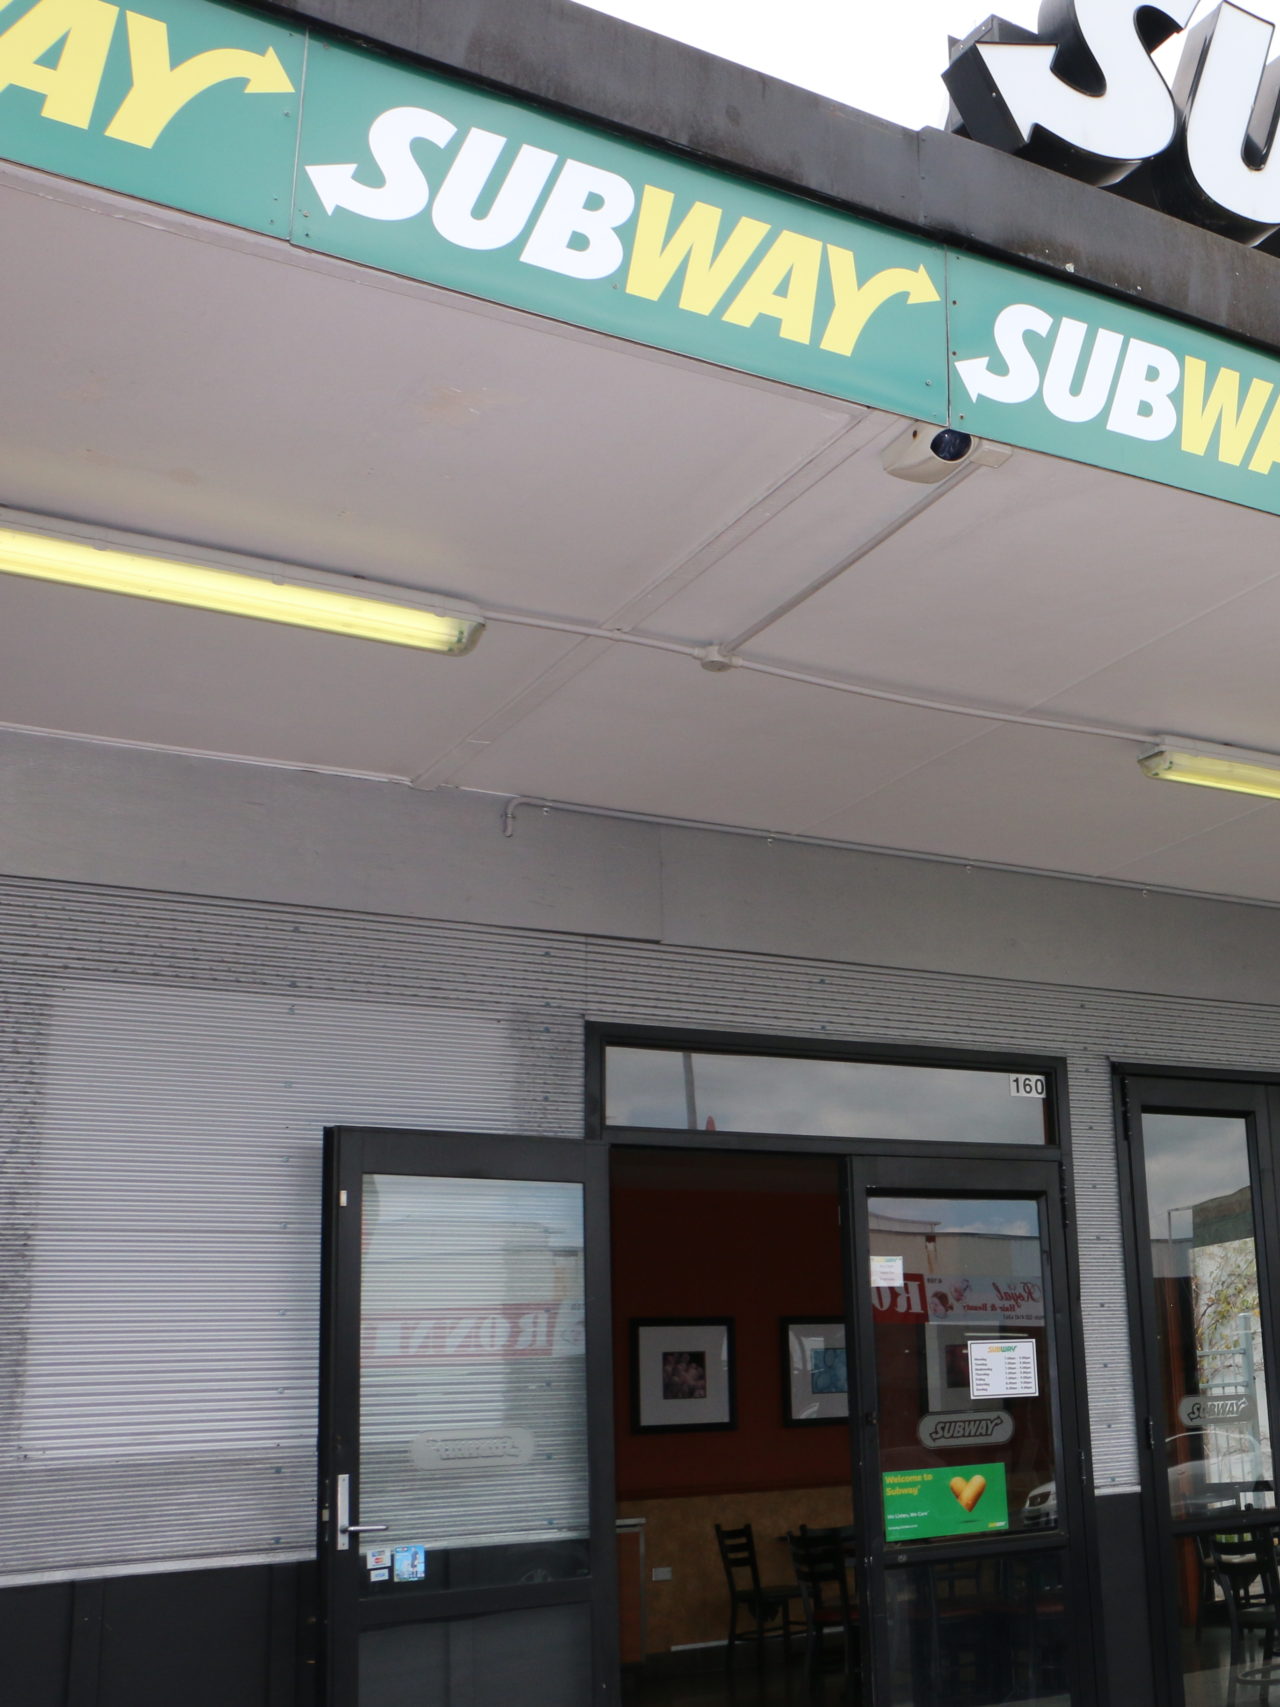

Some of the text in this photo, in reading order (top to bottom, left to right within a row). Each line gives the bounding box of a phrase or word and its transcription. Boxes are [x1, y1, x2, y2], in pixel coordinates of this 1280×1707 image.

[0, 0, 295, 149] AY
[305, 106, 941, 358] SUBWAY
[1012, 1077, 1045, 1095] 160
[987, 1345, 1017, 1353] SUBWAY
[929, 1416, 1004, 1442] SUBWAY
